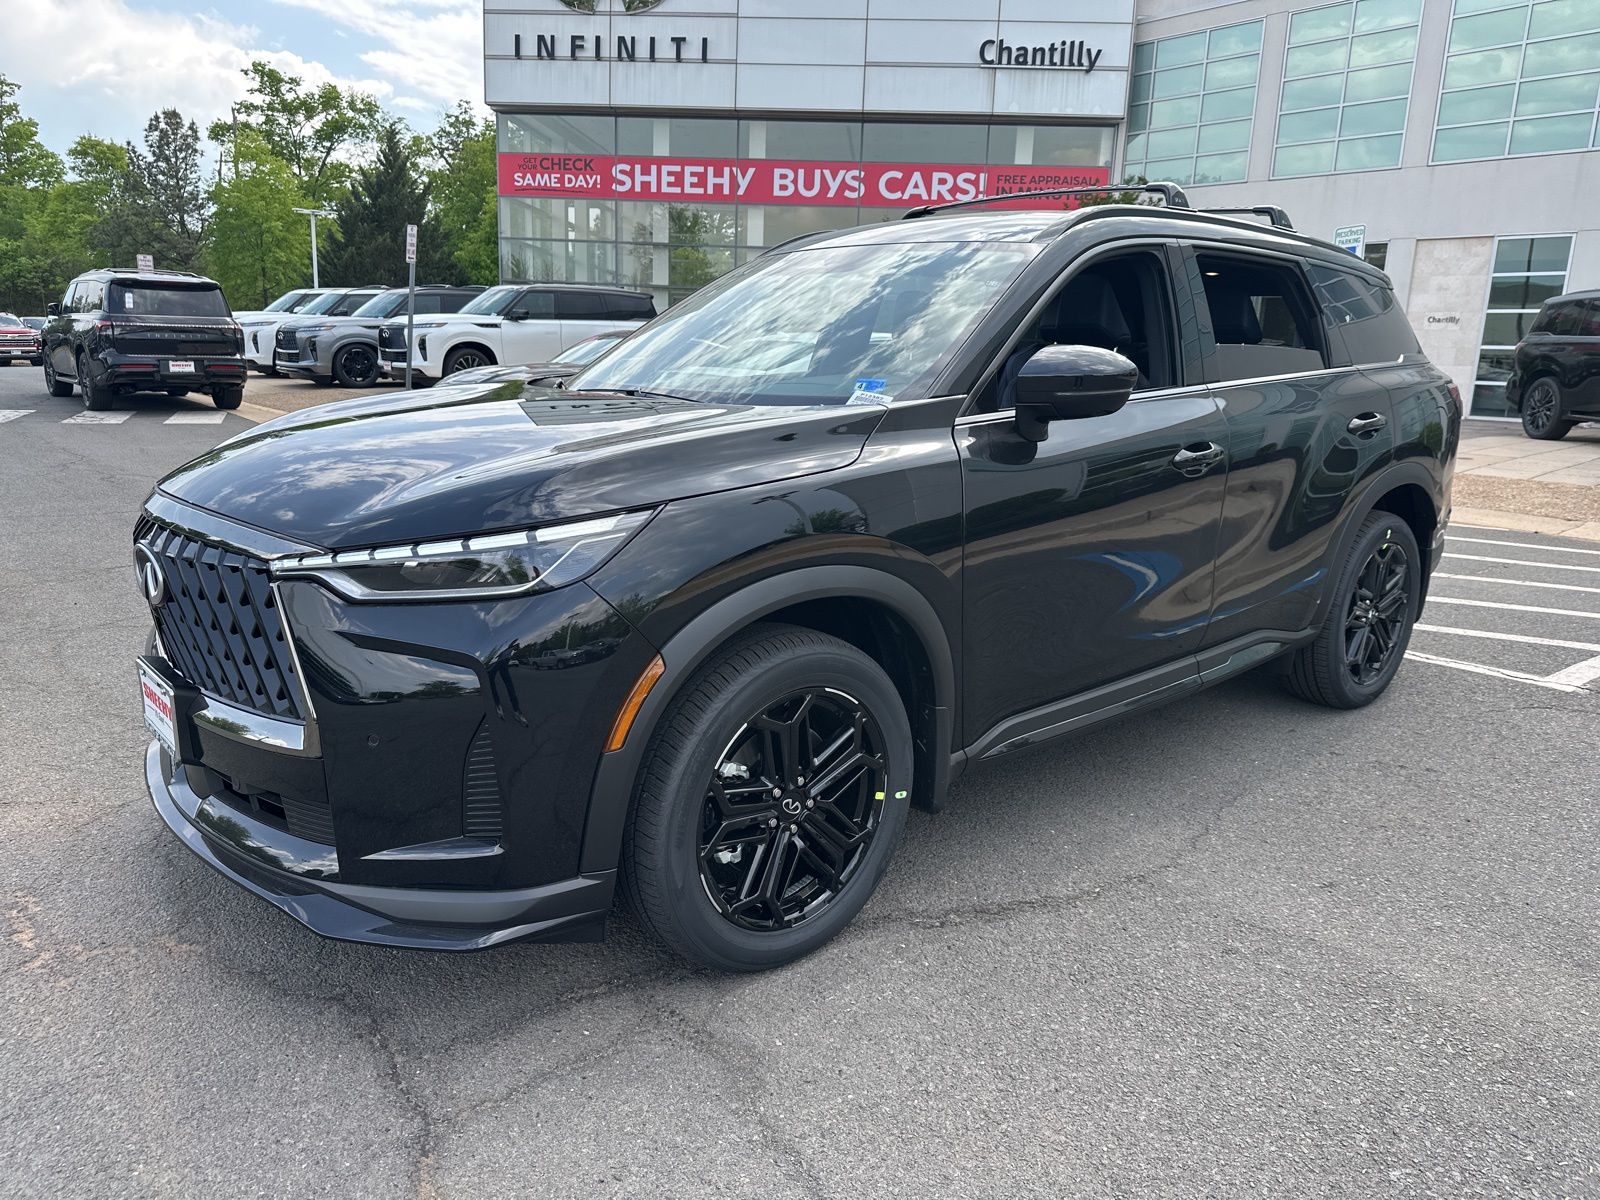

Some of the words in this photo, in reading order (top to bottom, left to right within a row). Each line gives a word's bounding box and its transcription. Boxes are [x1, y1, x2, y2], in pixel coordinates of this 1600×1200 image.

[513, 33, 708, 63] INFINITI
[979, 39, 1102, 73] Chantilly
[539, 157, 595, 172] CHECK
[513, 172, 561, 187] SAME
[564, 174, 601, 189] DAY!
[611, 163, 755, 196] SHEEHY
[773, 168, 865, 198] BUYS
[878, 170, 988, 200] CARS!
[997, 174, 1027, 185] FREE
[1427, 315, 1460, 325] Chantilly
[143, 681, 173, 720] SHEEHY
